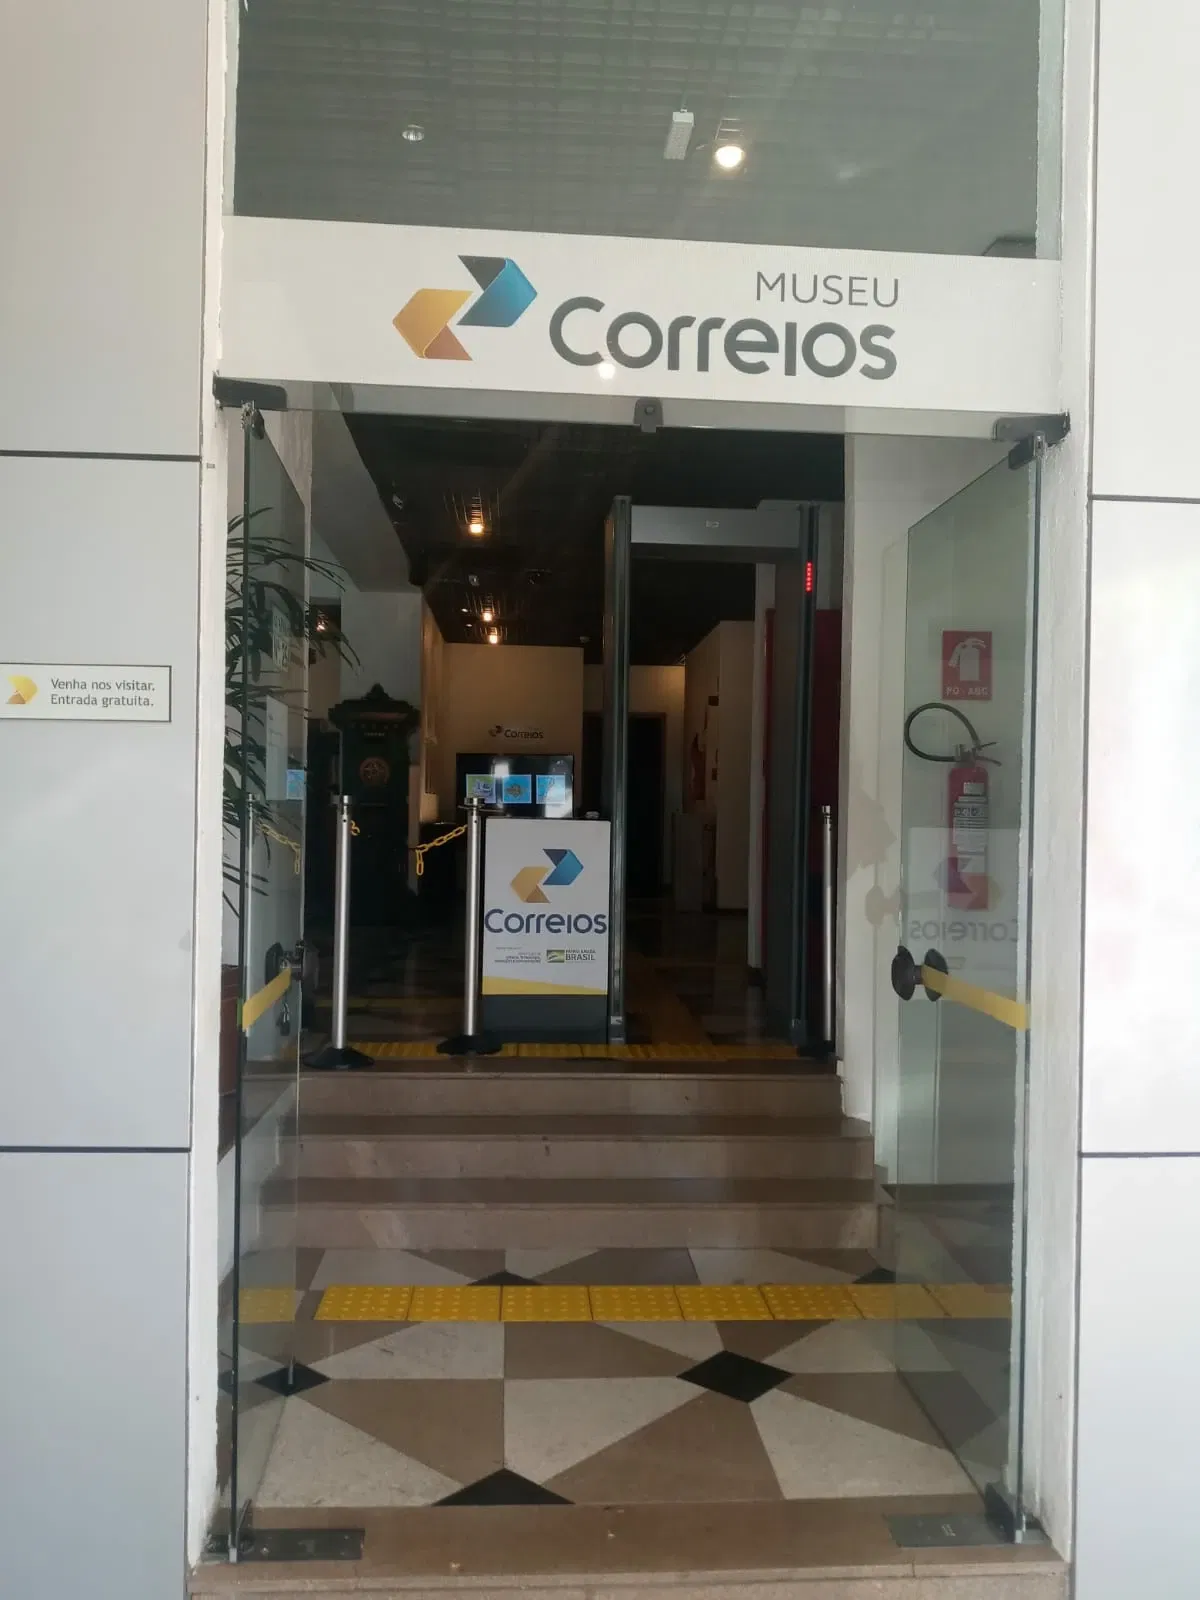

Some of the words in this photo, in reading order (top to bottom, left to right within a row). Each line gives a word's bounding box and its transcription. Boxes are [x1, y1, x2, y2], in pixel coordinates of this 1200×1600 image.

[756, 271, 899, 308] MUSEU
[549, 296, 897, 380] Correios
[51, 678, 87, 690] Venha
[91, 681, 112, 690] nos
[115, 679, 155, 691] visitar.
[51, 694, 98, 706] Entrada
[102, 695, 154, 708] gratuita.
[504, 729, 544, 739] Correios
[484, 908, 607, 934] Correios
[566, 953, 596, 961] BRASIL
